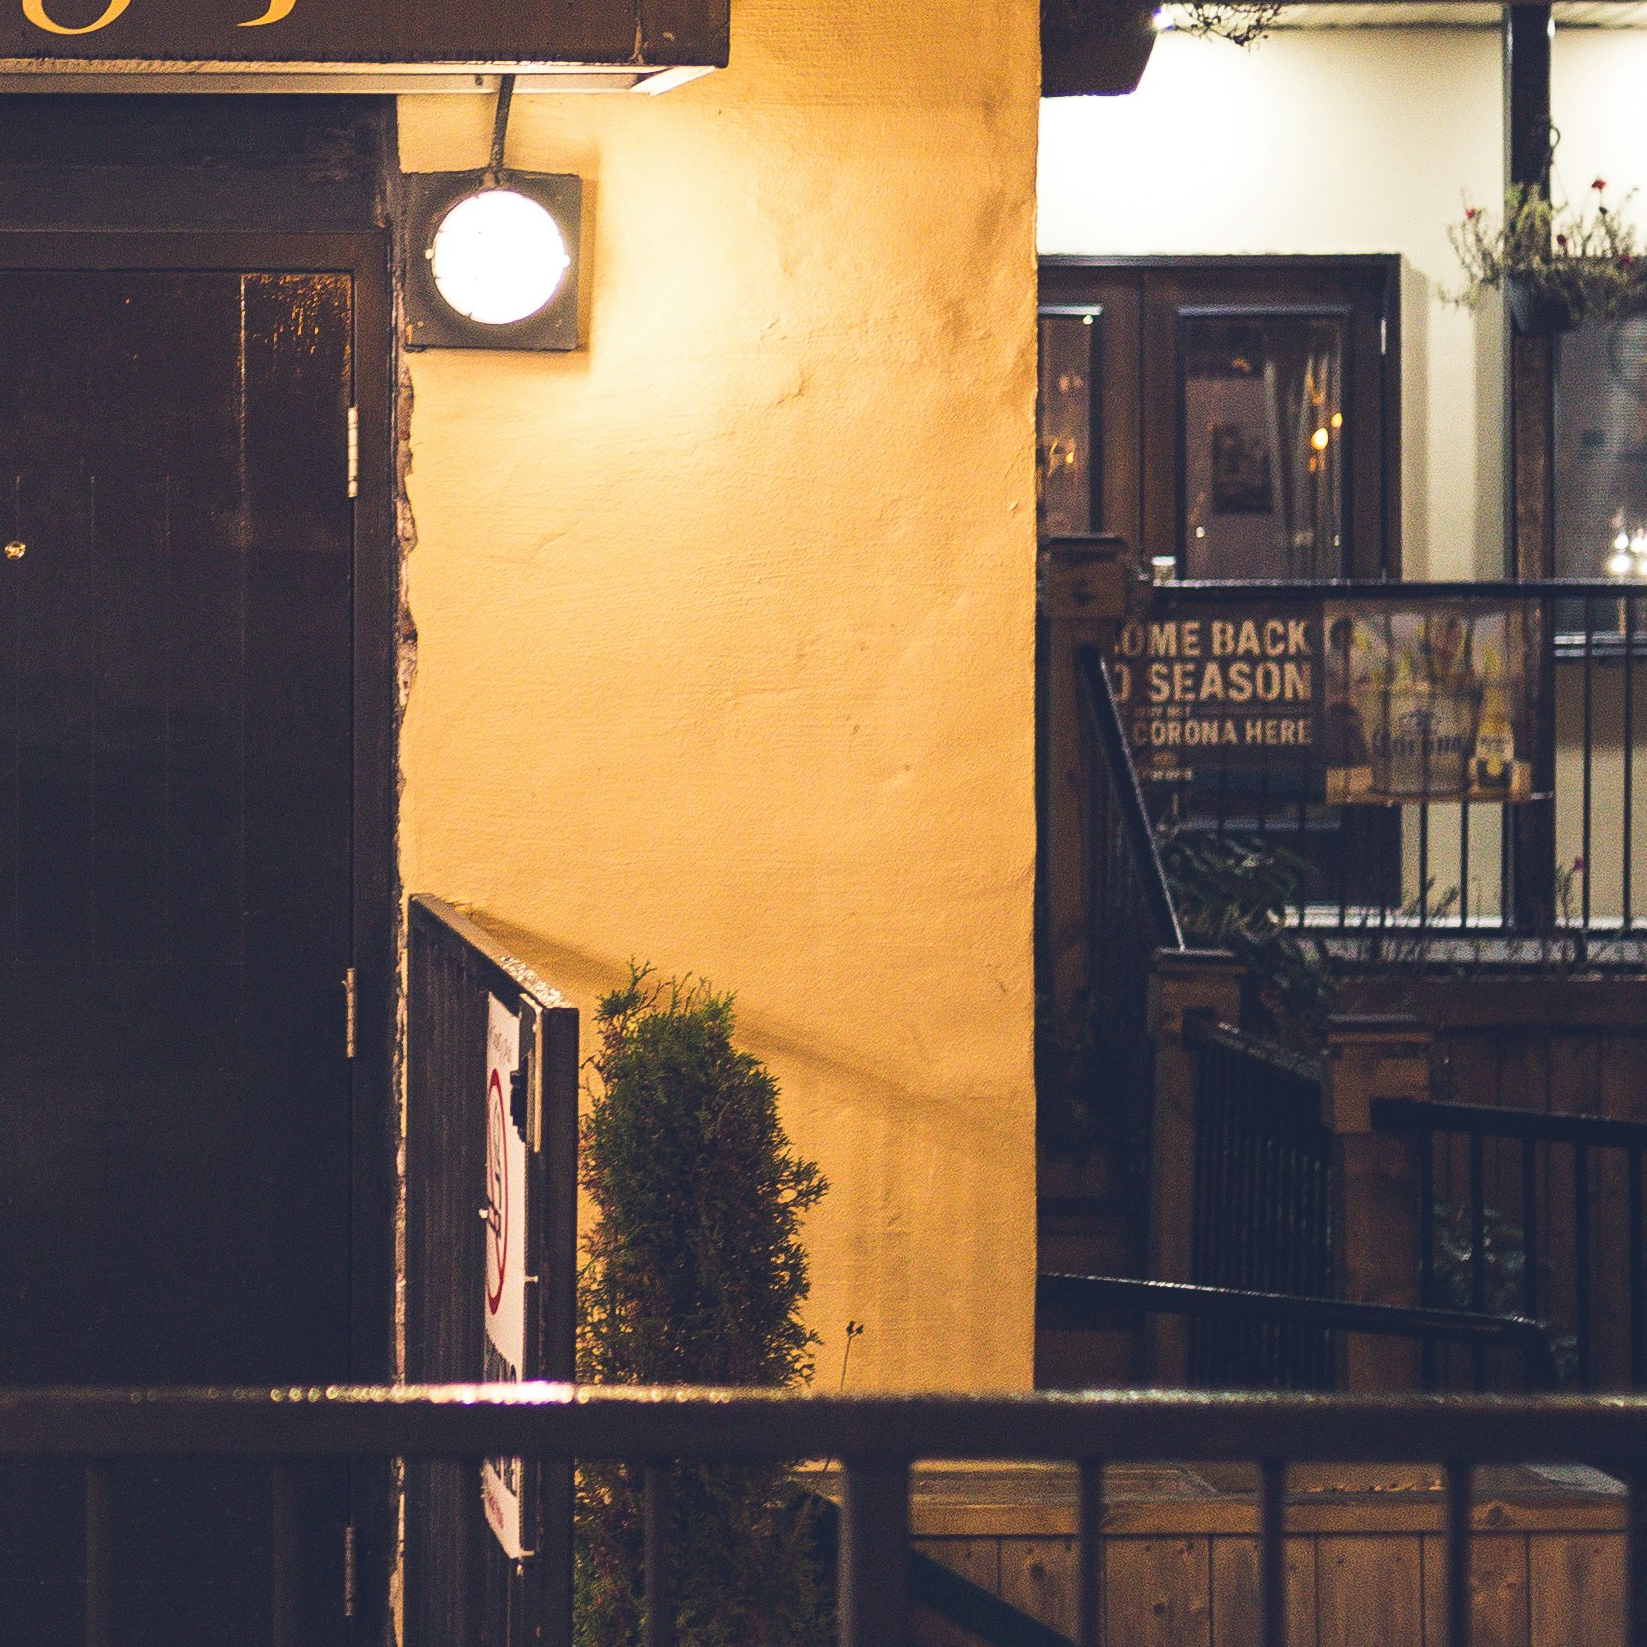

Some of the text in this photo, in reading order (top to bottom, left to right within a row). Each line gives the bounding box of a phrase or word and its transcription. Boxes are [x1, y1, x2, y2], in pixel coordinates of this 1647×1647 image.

[1114, 619, 1311, 657] OME BACK
[1147, 660, 1313, 703] SEASON
[1133, 718, 1313, 746] CORONA HERE
